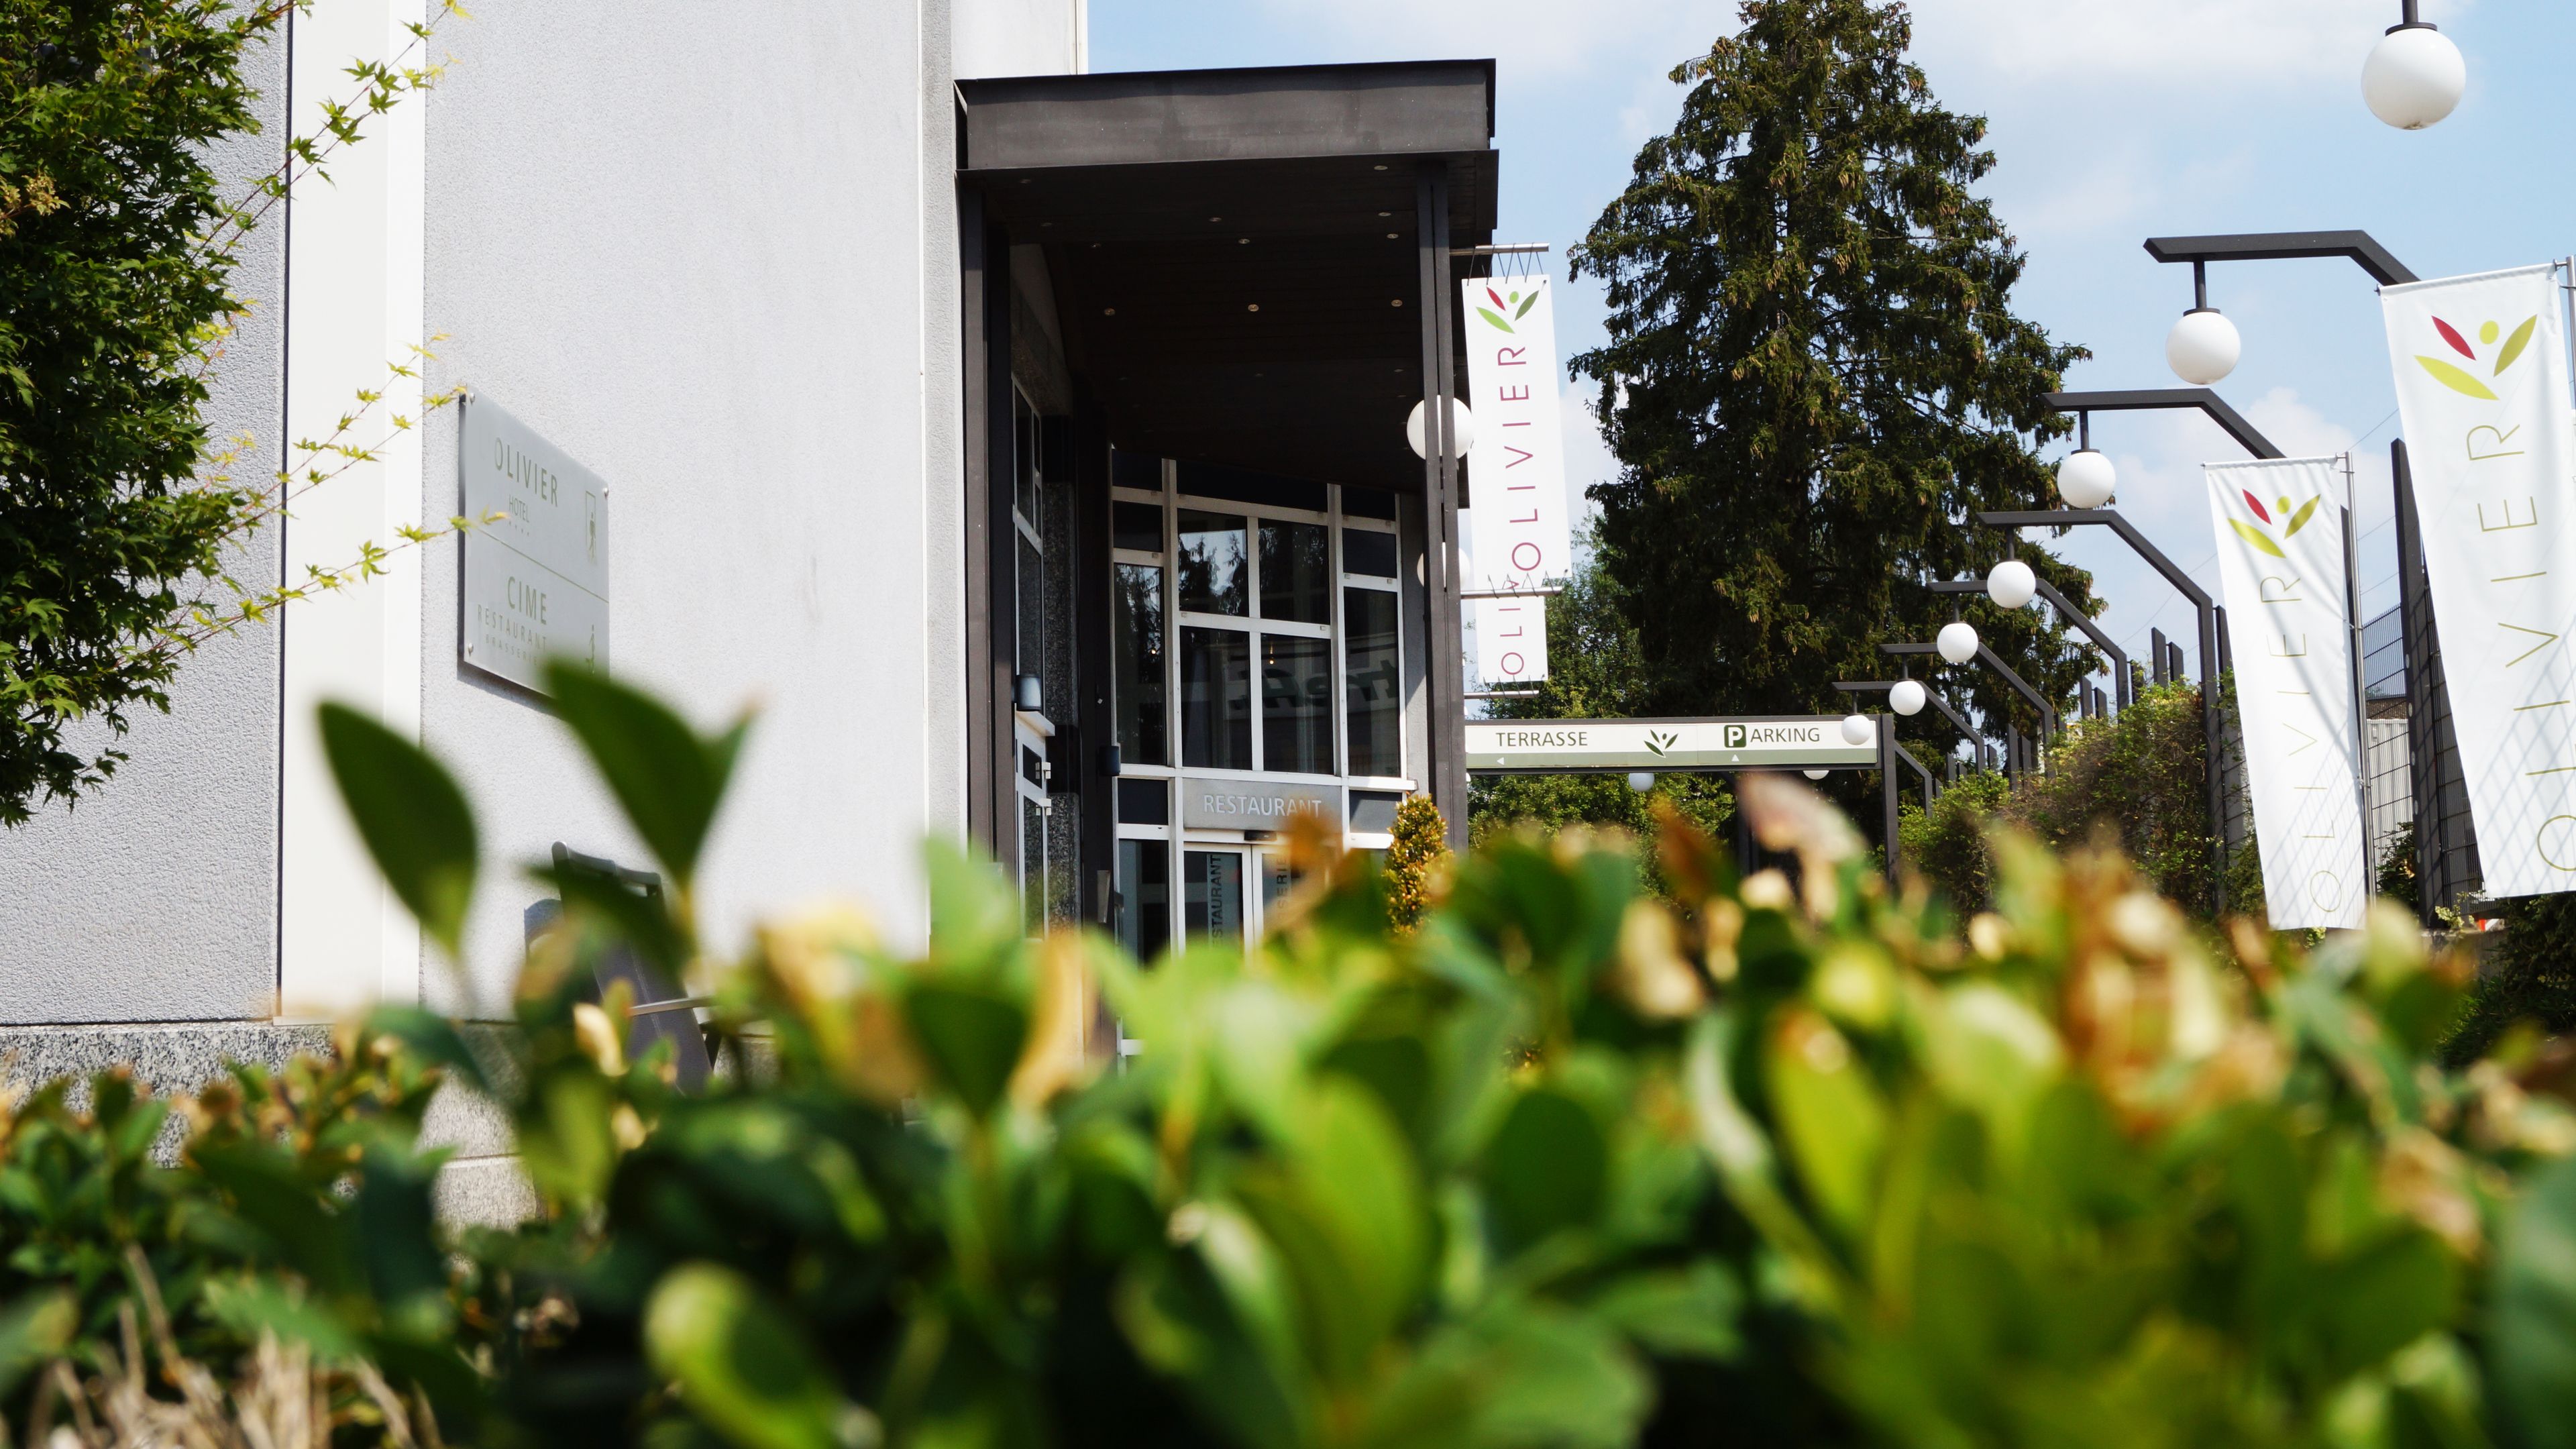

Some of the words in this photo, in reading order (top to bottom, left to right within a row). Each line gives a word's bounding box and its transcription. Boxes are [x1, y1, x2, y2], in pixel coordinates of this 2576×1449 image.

[494, 437, 557, 507] OLIVIER
[1497, 346, 1541, 570] OLIVIER
[508, 494, 529, 523] HOTEL
[478, 604, 547, 652] RESTAURANT
[507, 576, 547, 625] CIME
[2467, 424, 2576, 871] OLIVIER
[1496, 731, 1588, 747] TERRASSE
[2260, 576, 2342, 912] OLIVIER
[1203, 794, 1322, 818] RESTAURANT
[1210, 855, 1223, 942] STAURANT
